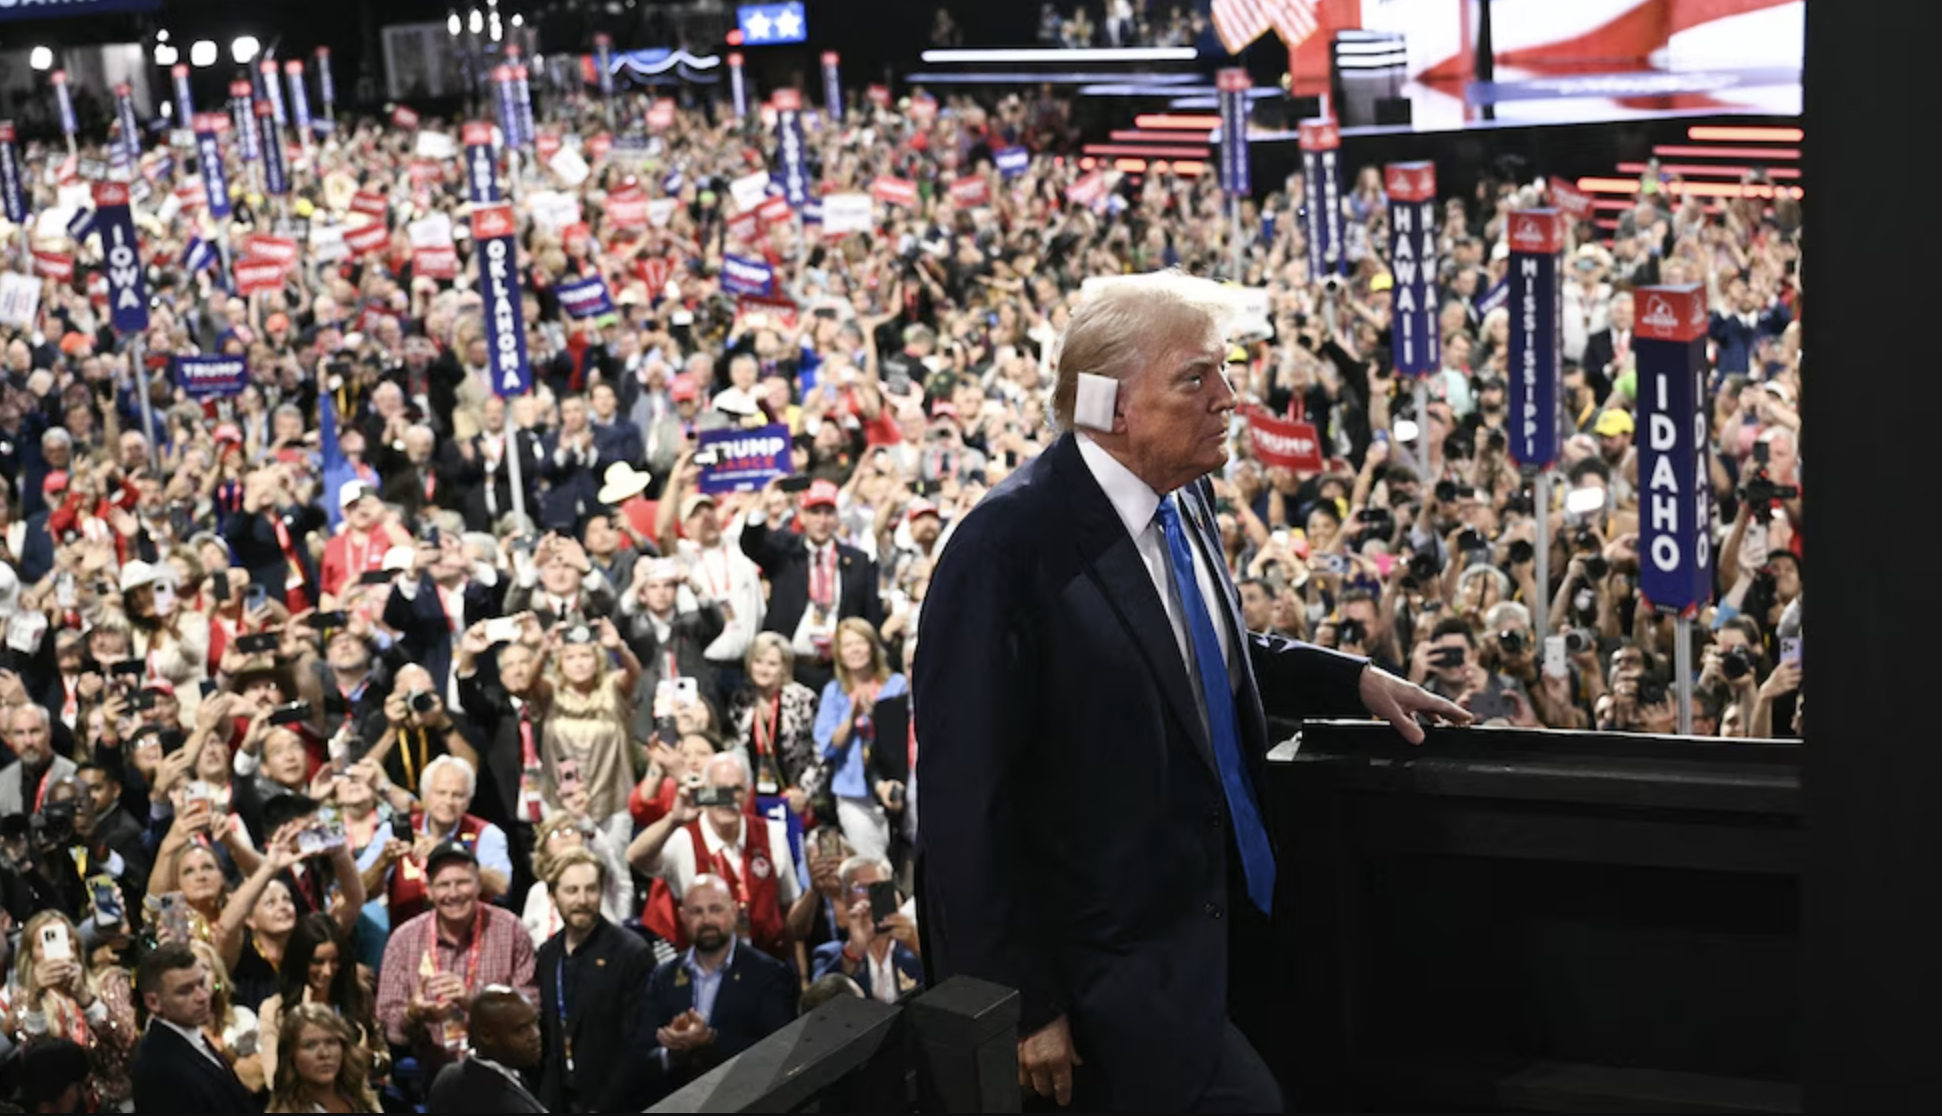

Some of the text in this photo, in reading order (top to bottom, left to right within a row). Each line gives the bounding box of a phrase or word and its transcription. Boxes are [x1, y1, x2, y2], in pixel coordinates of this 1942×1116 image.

[109, 224, 140, 310] IOWA
[486, 239, 521, 390] OKLAHOMA
[1394, 205, 1417, 365] HAWAII
[1420, 203, 1438, 363] HAWAII
[183, 361, 244, 378] TRUMP
[1521, 258, 1538, 457] MISSISSIPPI
[1251, 424, 1314, 454] TRUMP
[1650, 373, 1680, 572] IDAHO
[1694, 371, 1709, 569] IDAHO
